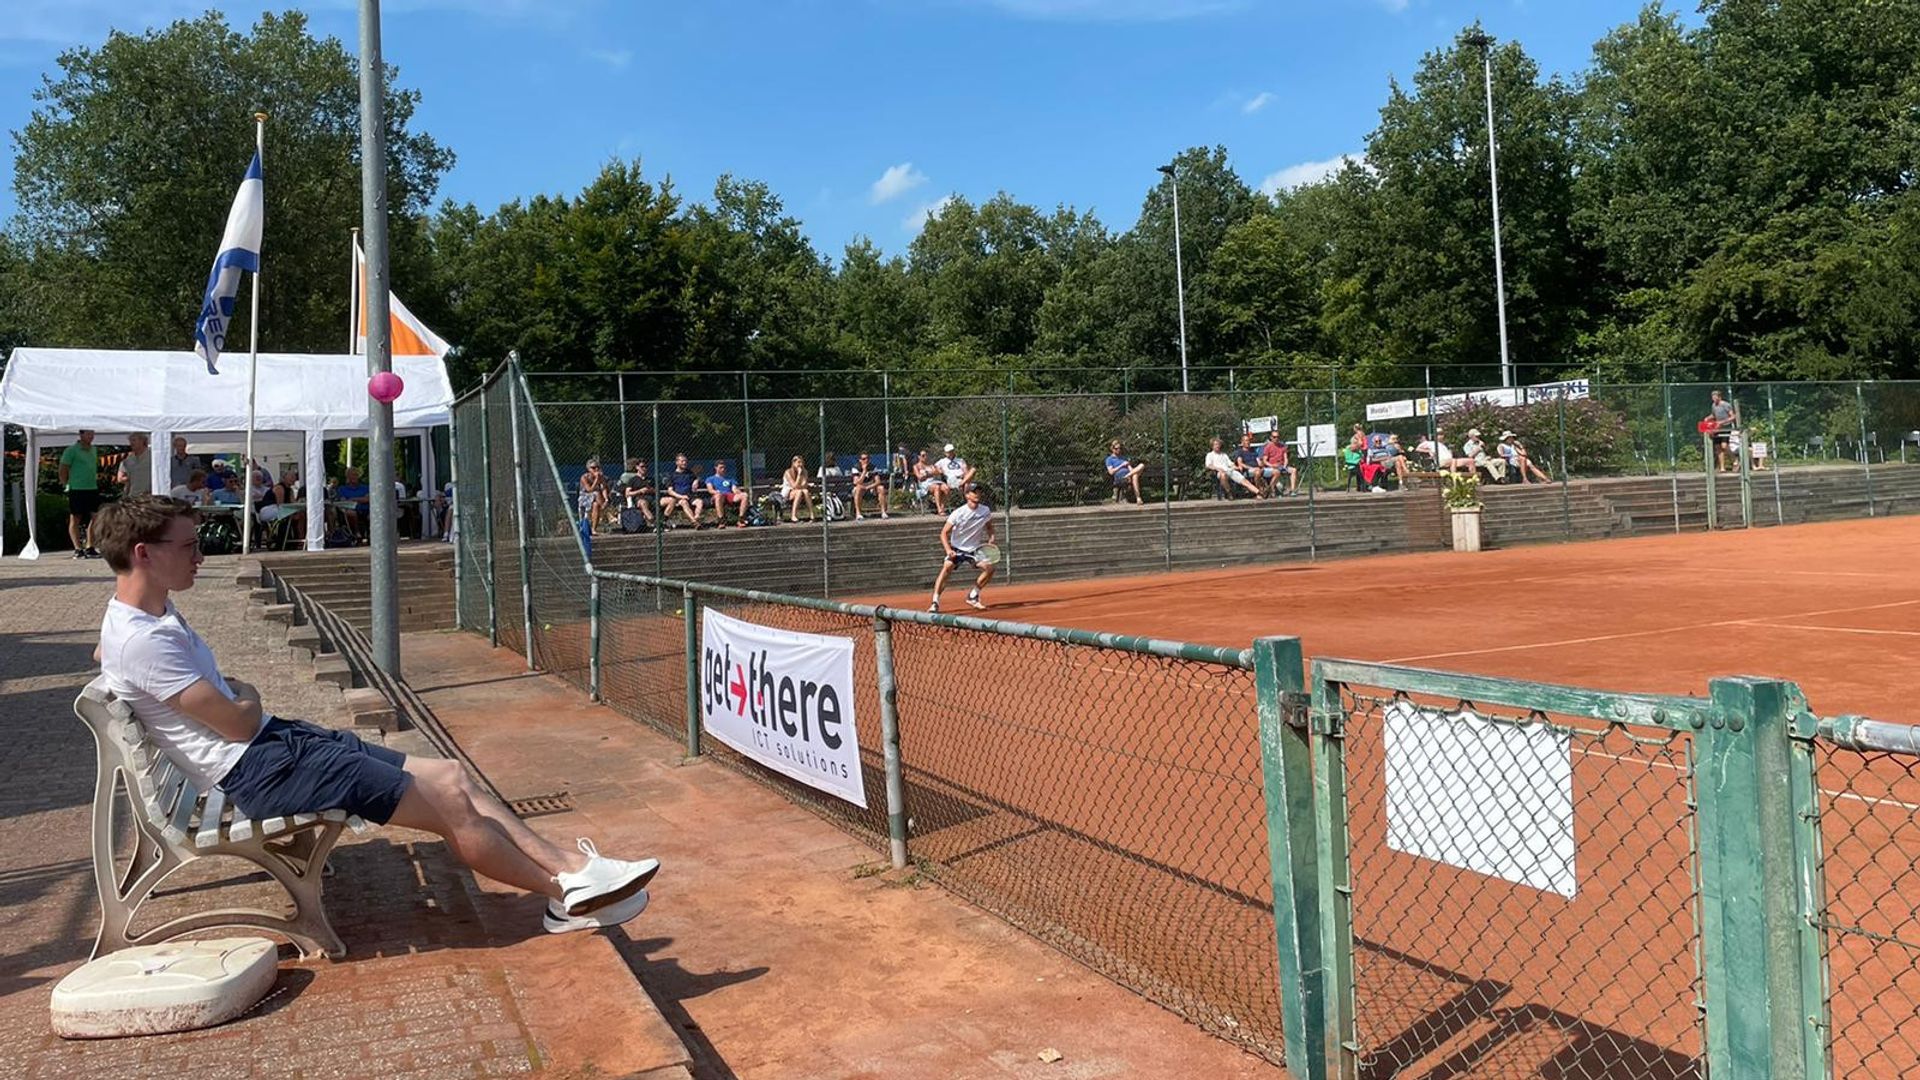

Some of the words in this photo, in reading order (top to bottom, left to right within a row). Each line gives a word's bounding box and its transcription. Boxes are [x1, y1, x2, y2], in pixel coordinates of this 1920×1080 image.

[705, 643, 732, 715] get
[749, 649, 843, 750] there
[752, 728, 770, 750] ICT
[777, 742, 849, 779] solutions
